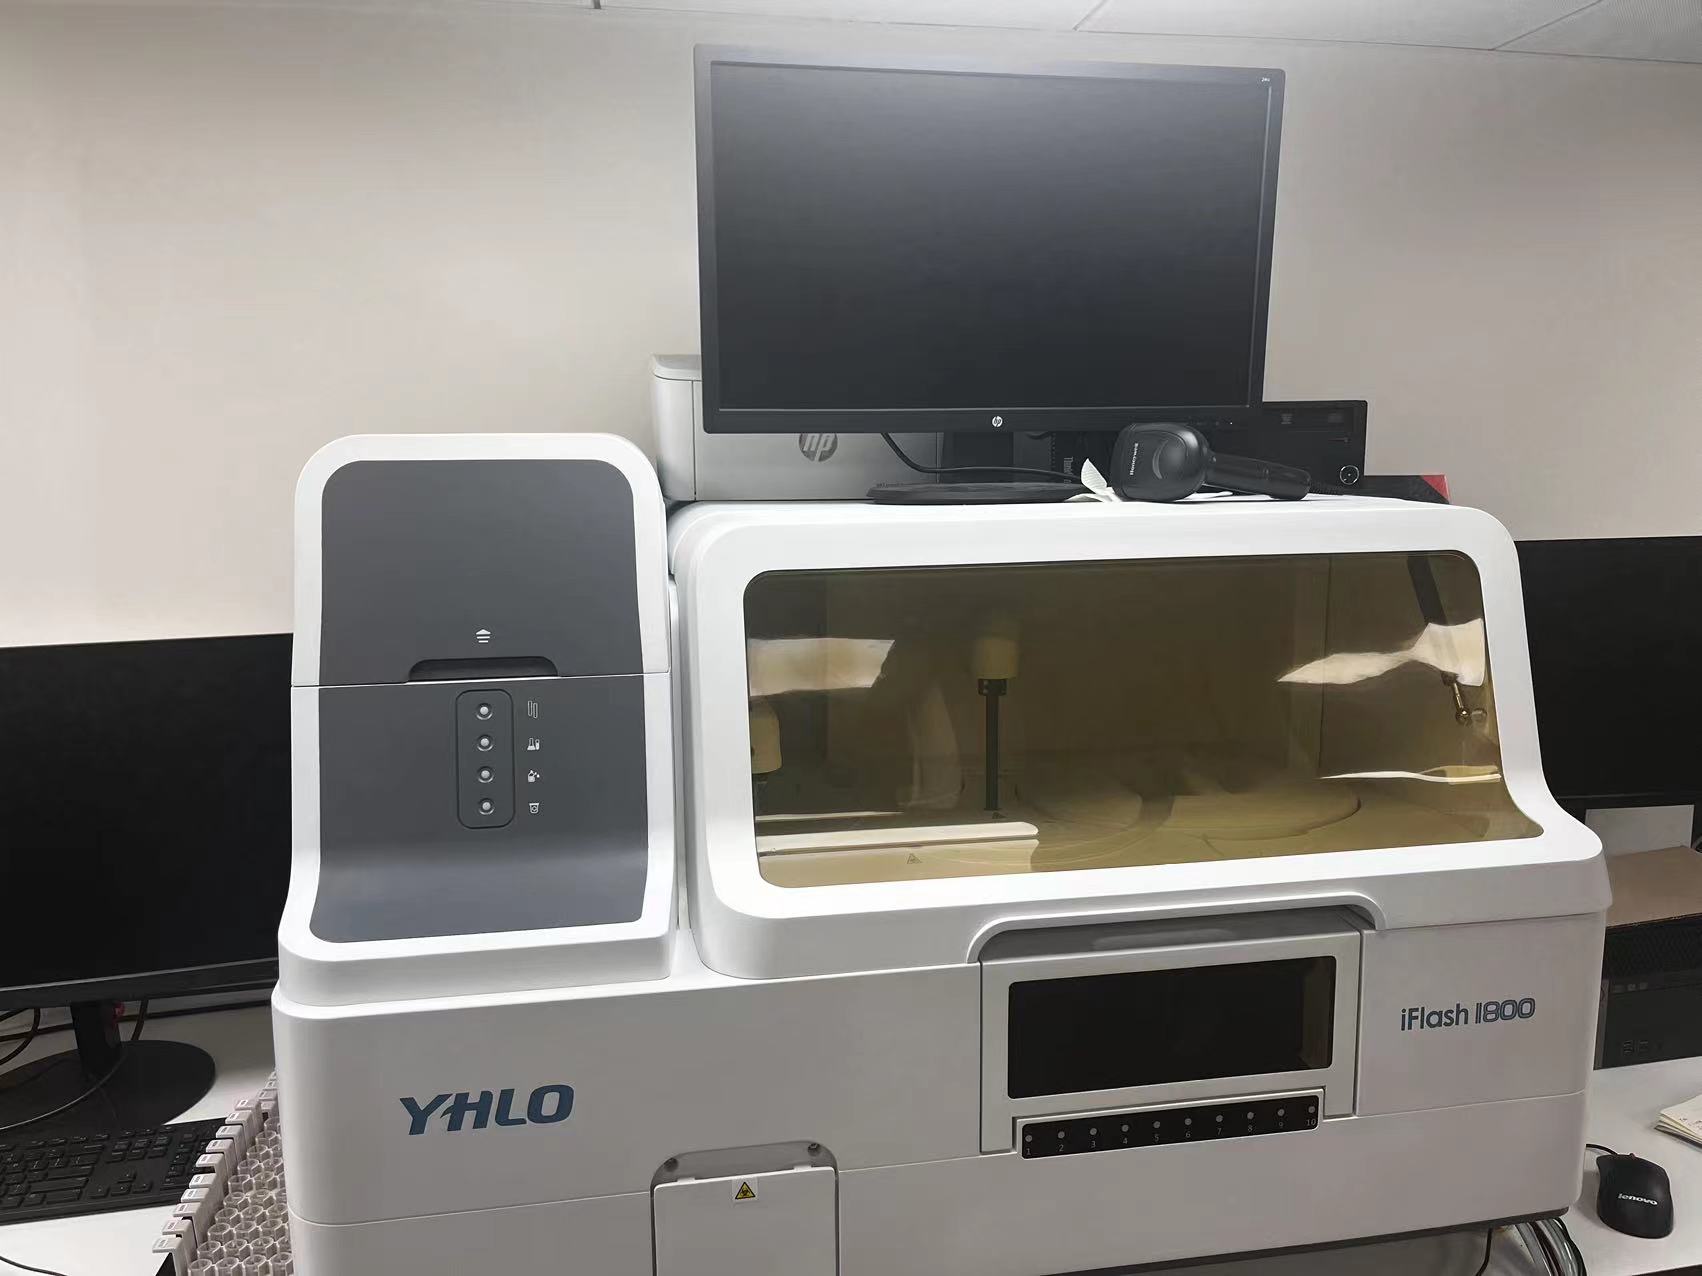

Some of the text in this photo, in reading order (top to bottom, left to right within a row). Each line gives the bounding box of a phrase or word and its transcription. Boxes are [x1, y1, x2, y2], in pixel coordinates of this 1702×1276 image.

[1400, 997, 1536, 1031] iFlash 1800
[400, 1084, 575, 1135] YHLO
[1026, 1148, 1031, 1156] 1
[1058, 1144, 1064, 1152] 2
[1091, 1140, 1096, 1149] 3
[1122, 1137, 1128, 1145] 4
[1154, 1134, 1159, 1142] 5
[1185, 1130, 1191, 1138] 6
[1217, 1127, 1222, 1136] 7
[1278, 1121, 1284, 1129] 9
[1306, 1118, 1316, 1126] 10
